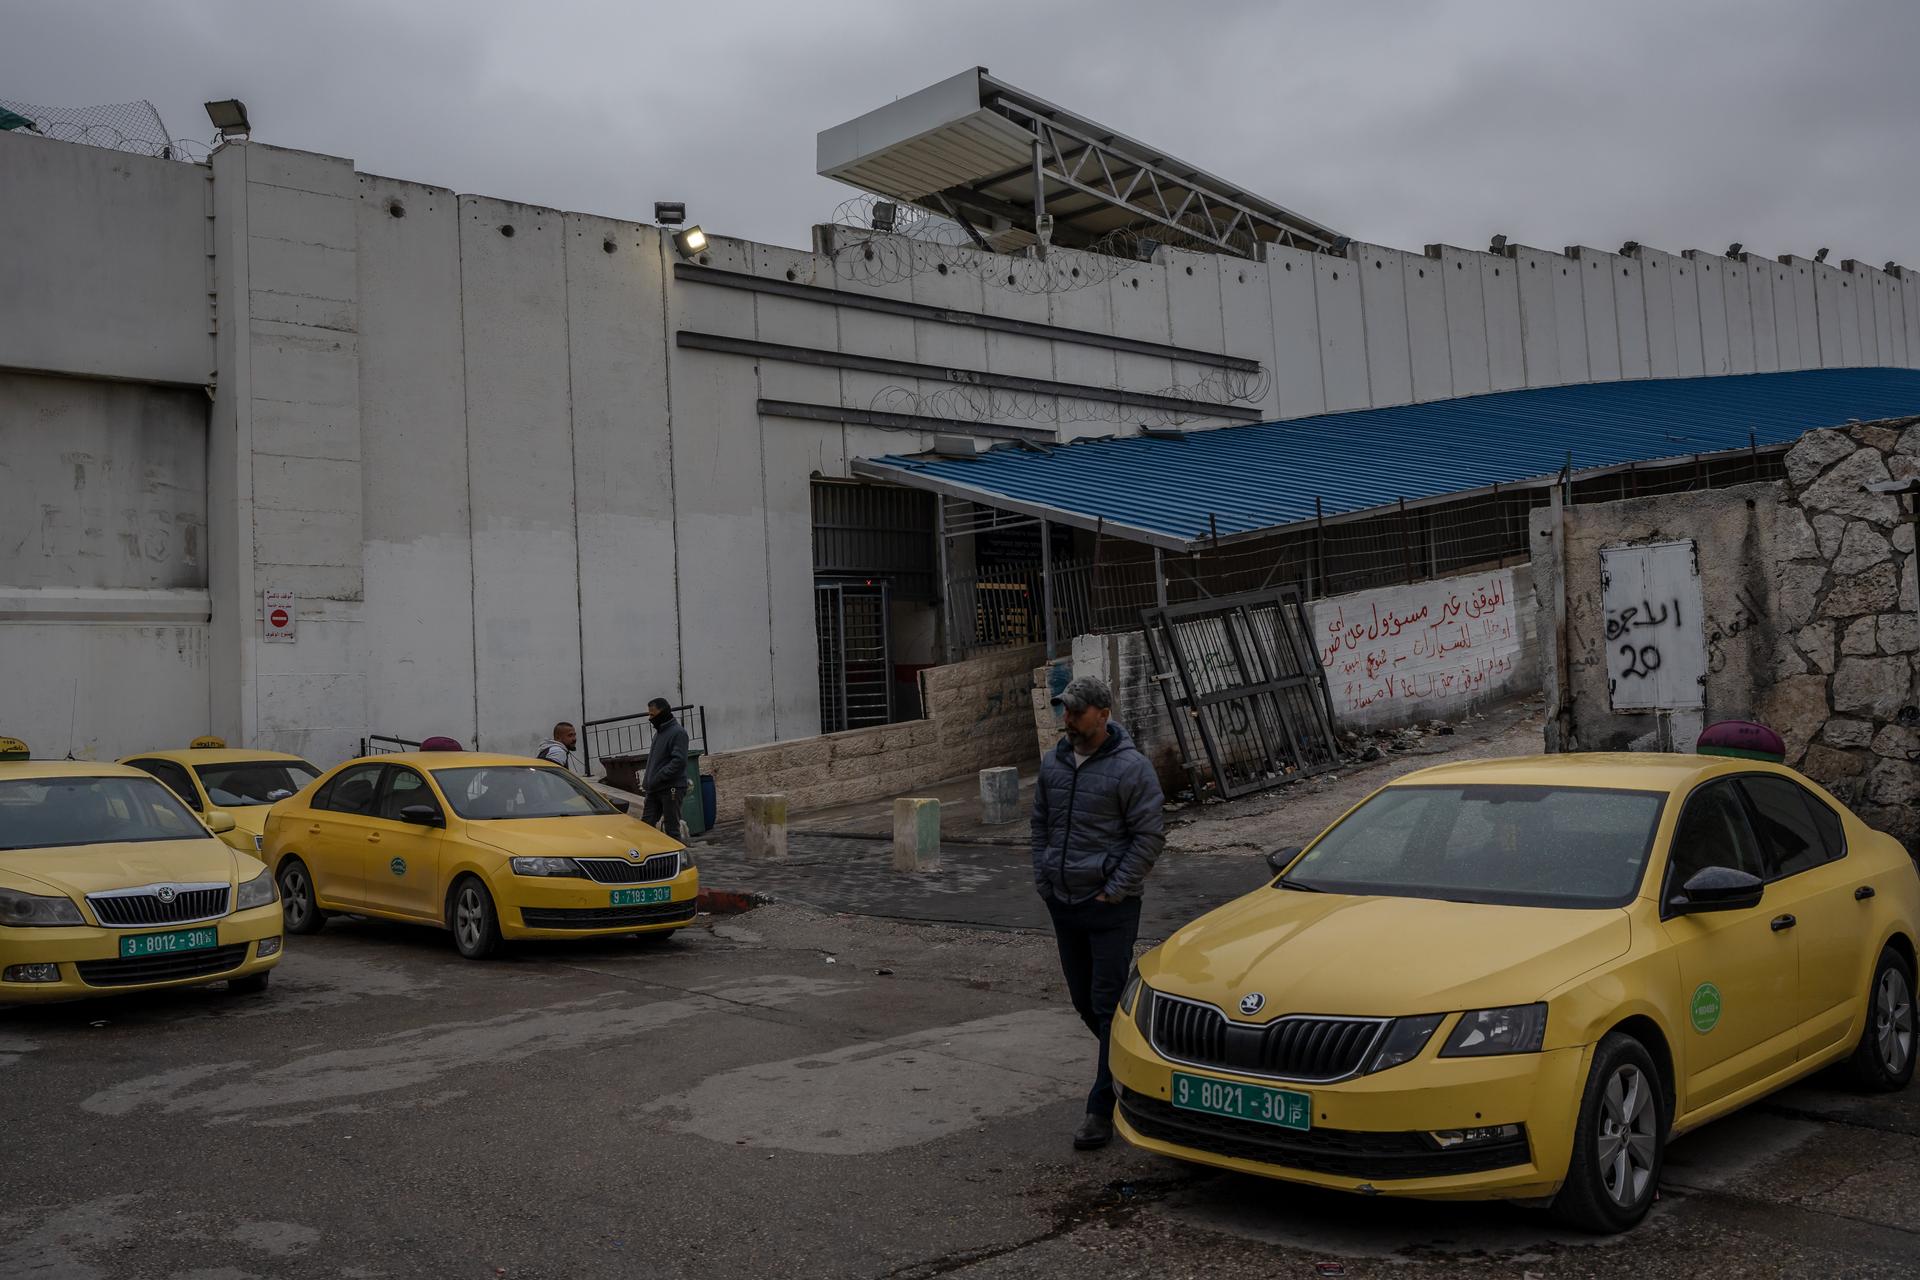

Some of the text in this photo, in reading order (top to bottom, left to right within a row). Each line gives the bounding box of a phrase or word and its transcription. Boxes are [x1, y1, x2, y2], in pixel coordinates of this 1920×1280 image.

[1430, 591, 1461, 628] غير
[1466, 579, 1504, 619] الموقف
[1345, 623, 1364, 649] عن
[1619, 644, 1661, 679] 20
